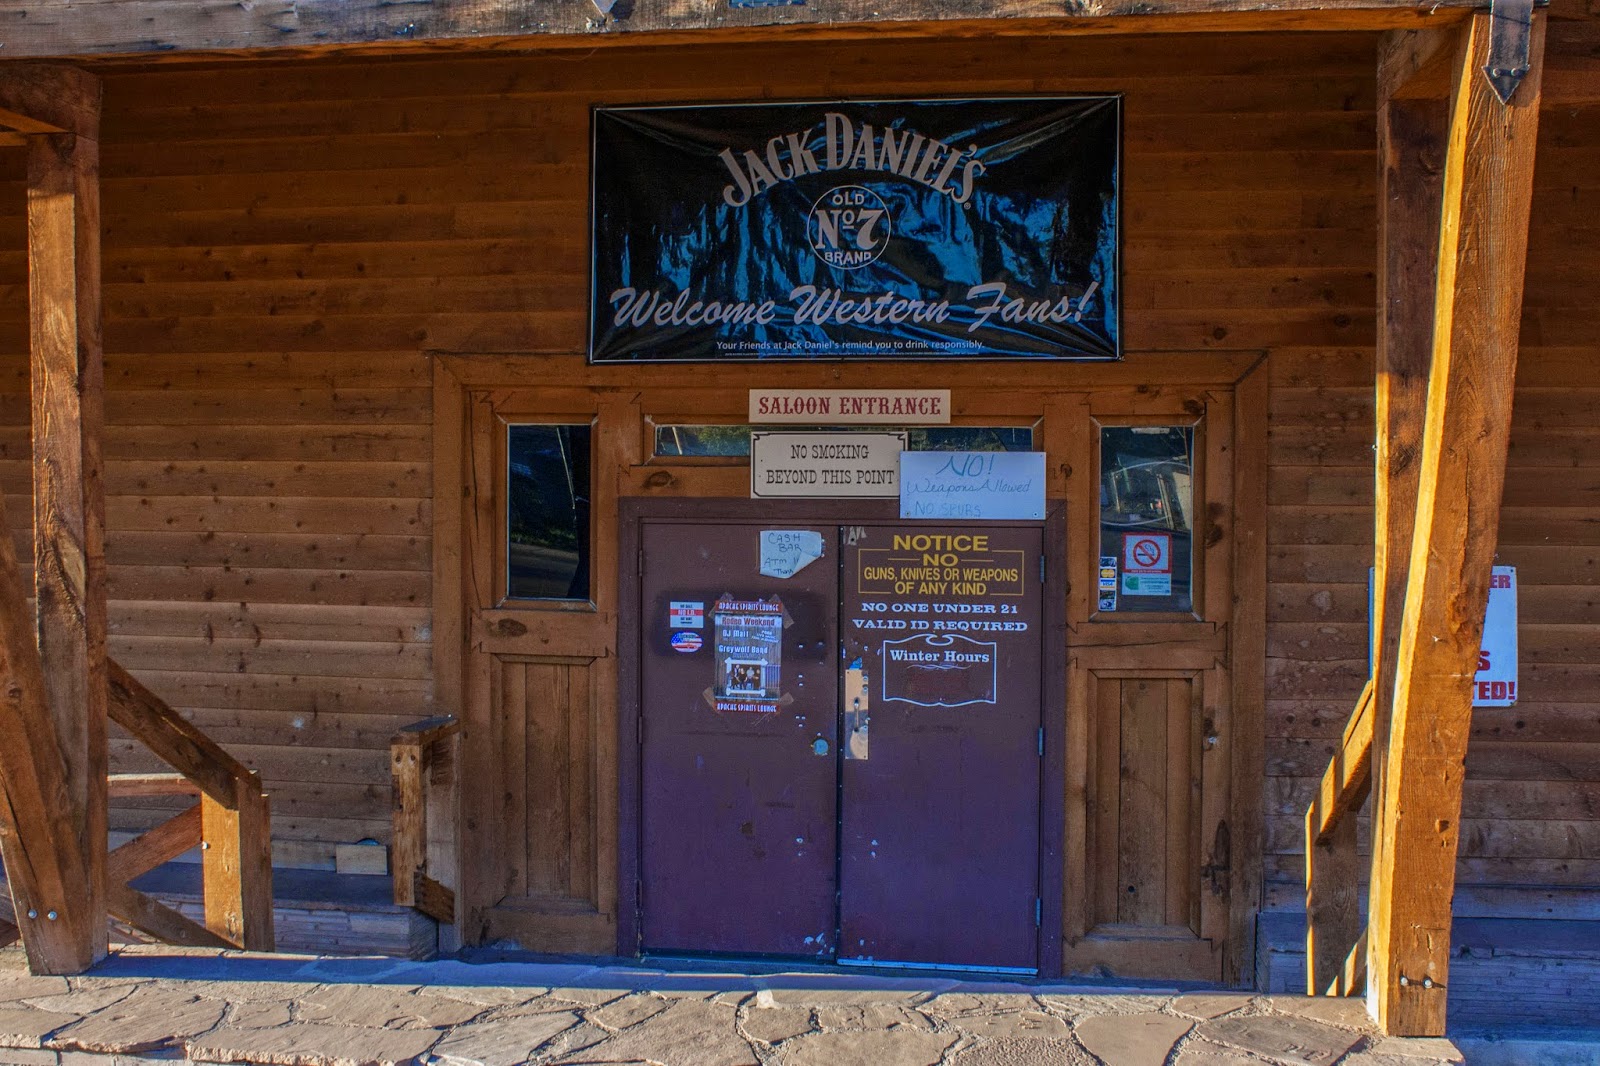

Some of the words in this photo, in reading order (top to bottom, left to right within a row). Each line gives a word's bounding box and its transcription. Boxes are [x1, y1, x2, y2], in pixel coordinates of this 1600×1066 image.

[718, 128, 820, 207] JACK
[824, 112, 987, 204] DANIEL'S
[832, 193, 865, 206] OLD
[824, 250, 872, 266] BRAND
[610, 287, 775, 328] Welcome
[789, 284, 950, 326] Western
[966, 281, 1099, 333] Fans!
[716, 341, 738, 349] Your
[739, 341, 770, 349] Friends
[783, 341, 801, 350] Jack
[804, 340, 840, 349] Daniel's
[842, 340, 873, 349] remind
[875, 342, 891, 351] you
[894, 341, 903, 349] to
[905, 340, 928, 349] drink
[931, 340, 985, 350] responsibly.
[758, 396, 831, 415] SALOON
[839, 396, 941, 415] ENTRANCE
[791, 444, 808, 459] NO
[812, 444, 869, 460] SMOKING
[936, 453, 995, 477] NO!
[766, 469, 817, 485] BEYOND
[822, 469, 852, 485] THIS
[856, 469, 895, 485] POINT
[915, 501, 935, 516] NO
[940, 503, 982, 518] SPURS
[768, 532, 801, 544] CASH
[893, 534, 989, 552] NOTICE
[778, 543, 803, 553] BAR
[922, 553, 959, 567] NO
[864, 566, 898, 582] GUNS,
[901, 567, 940, 581] KNIVES
[943, 568, 960, 581] OR
[962, 568, 1018, 582] WEAPONS
[894, 581, 915, 595] OF
[918, 582, 948, 595] ANY
[952, 582, 987, 596] KIND
[861, 602, 887, 612] NO
[891, 602, 929, 613] ONE
[933, 603, 996, 614] UNDER
[1000, 604, 1018, 614] 21
[743, 617, 775, 627] Weekend
[852, 619, 907, 630] VALID
[910, 620, 930, 630] ID
[933, 620, 1028, 632] REQUIRED
[722, 629, 731, 637] DJ
[751, 646, 768, 654] Band
[890, 649, 940, 662] Winter
[944, 650, 990, 663] Hours
